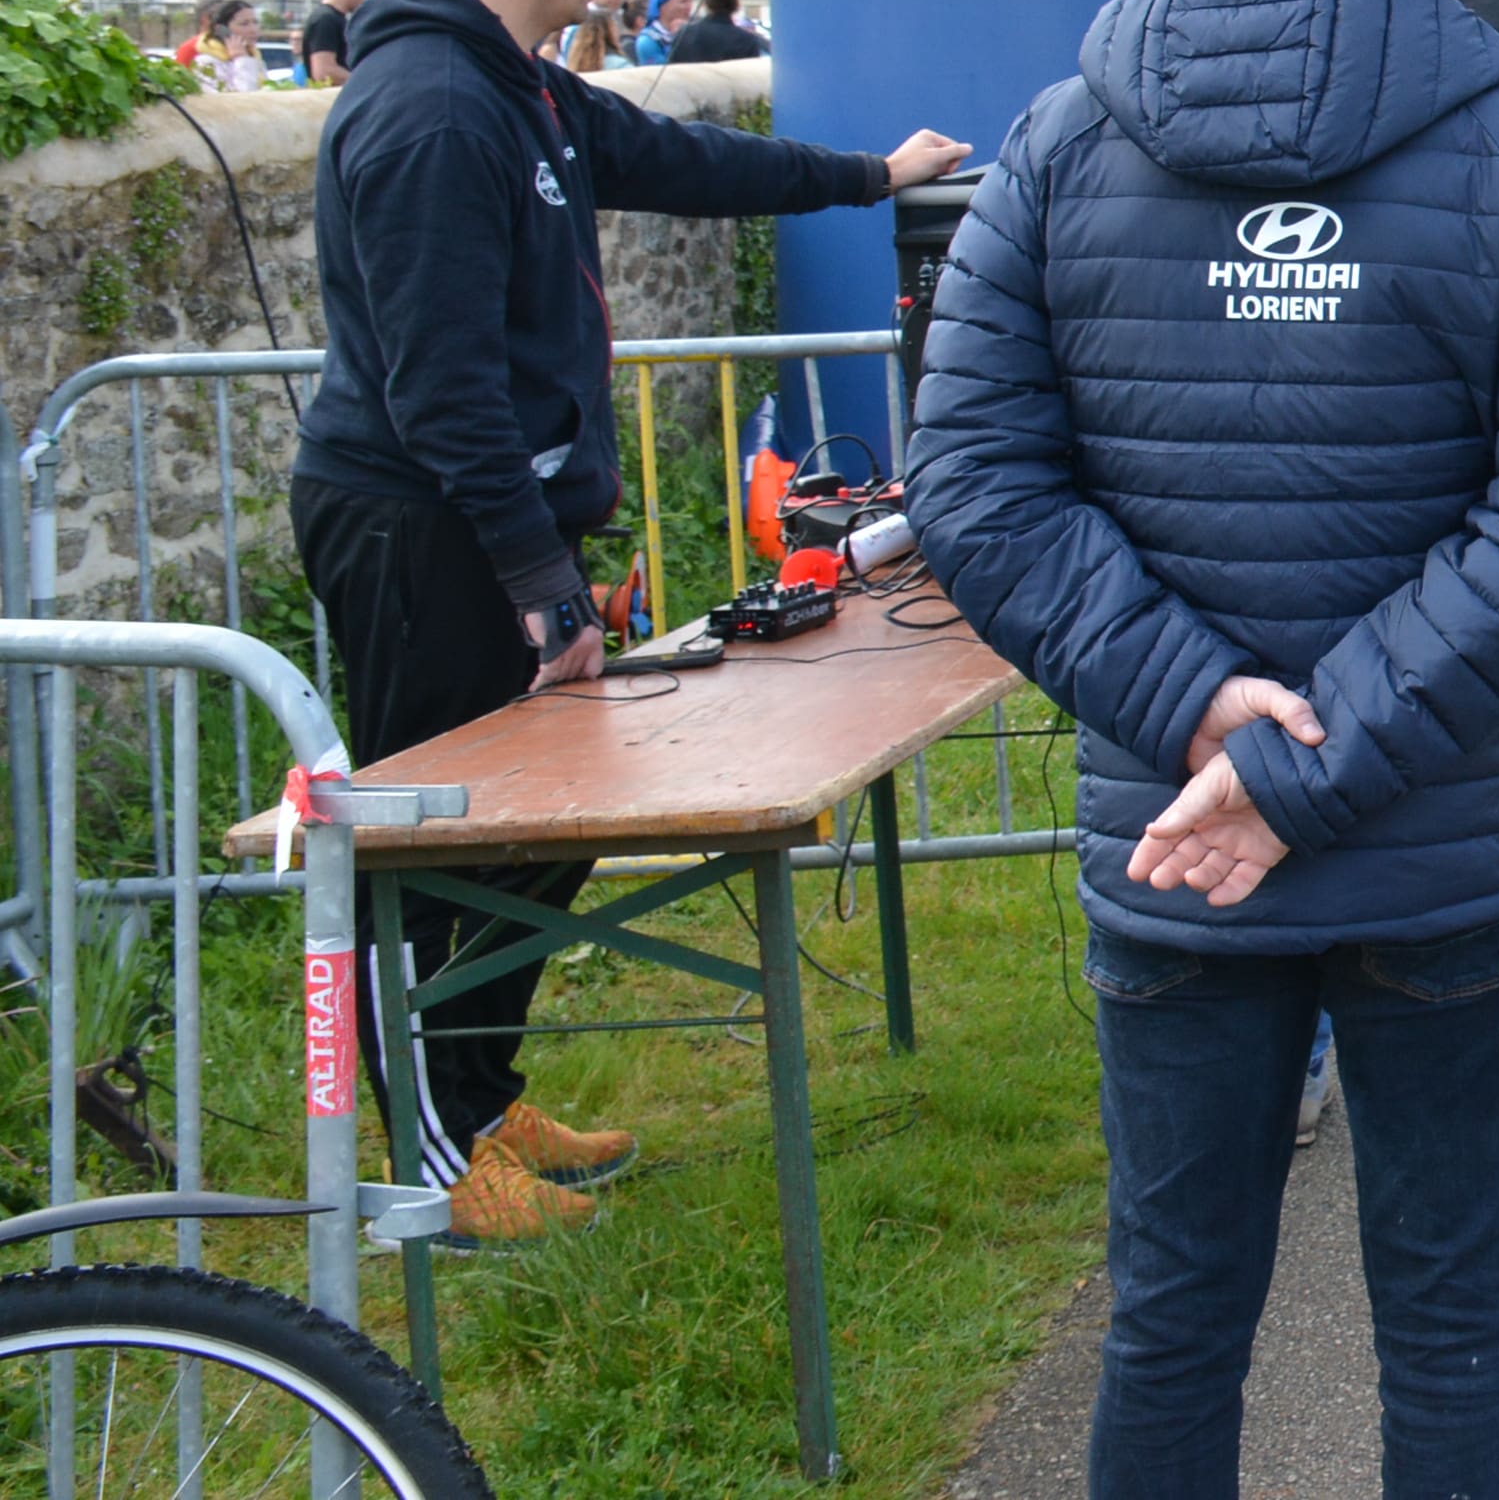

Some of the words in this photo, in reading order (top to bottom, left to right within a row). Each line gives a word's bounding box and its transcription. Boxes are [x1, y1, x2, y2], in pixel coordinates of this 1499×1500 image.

[1207, 261, 1361, 290] HYUNDAI
[1226, 295, 1342, 322] LORIENT
[309, 959, 336, 1110] ALTRAD
